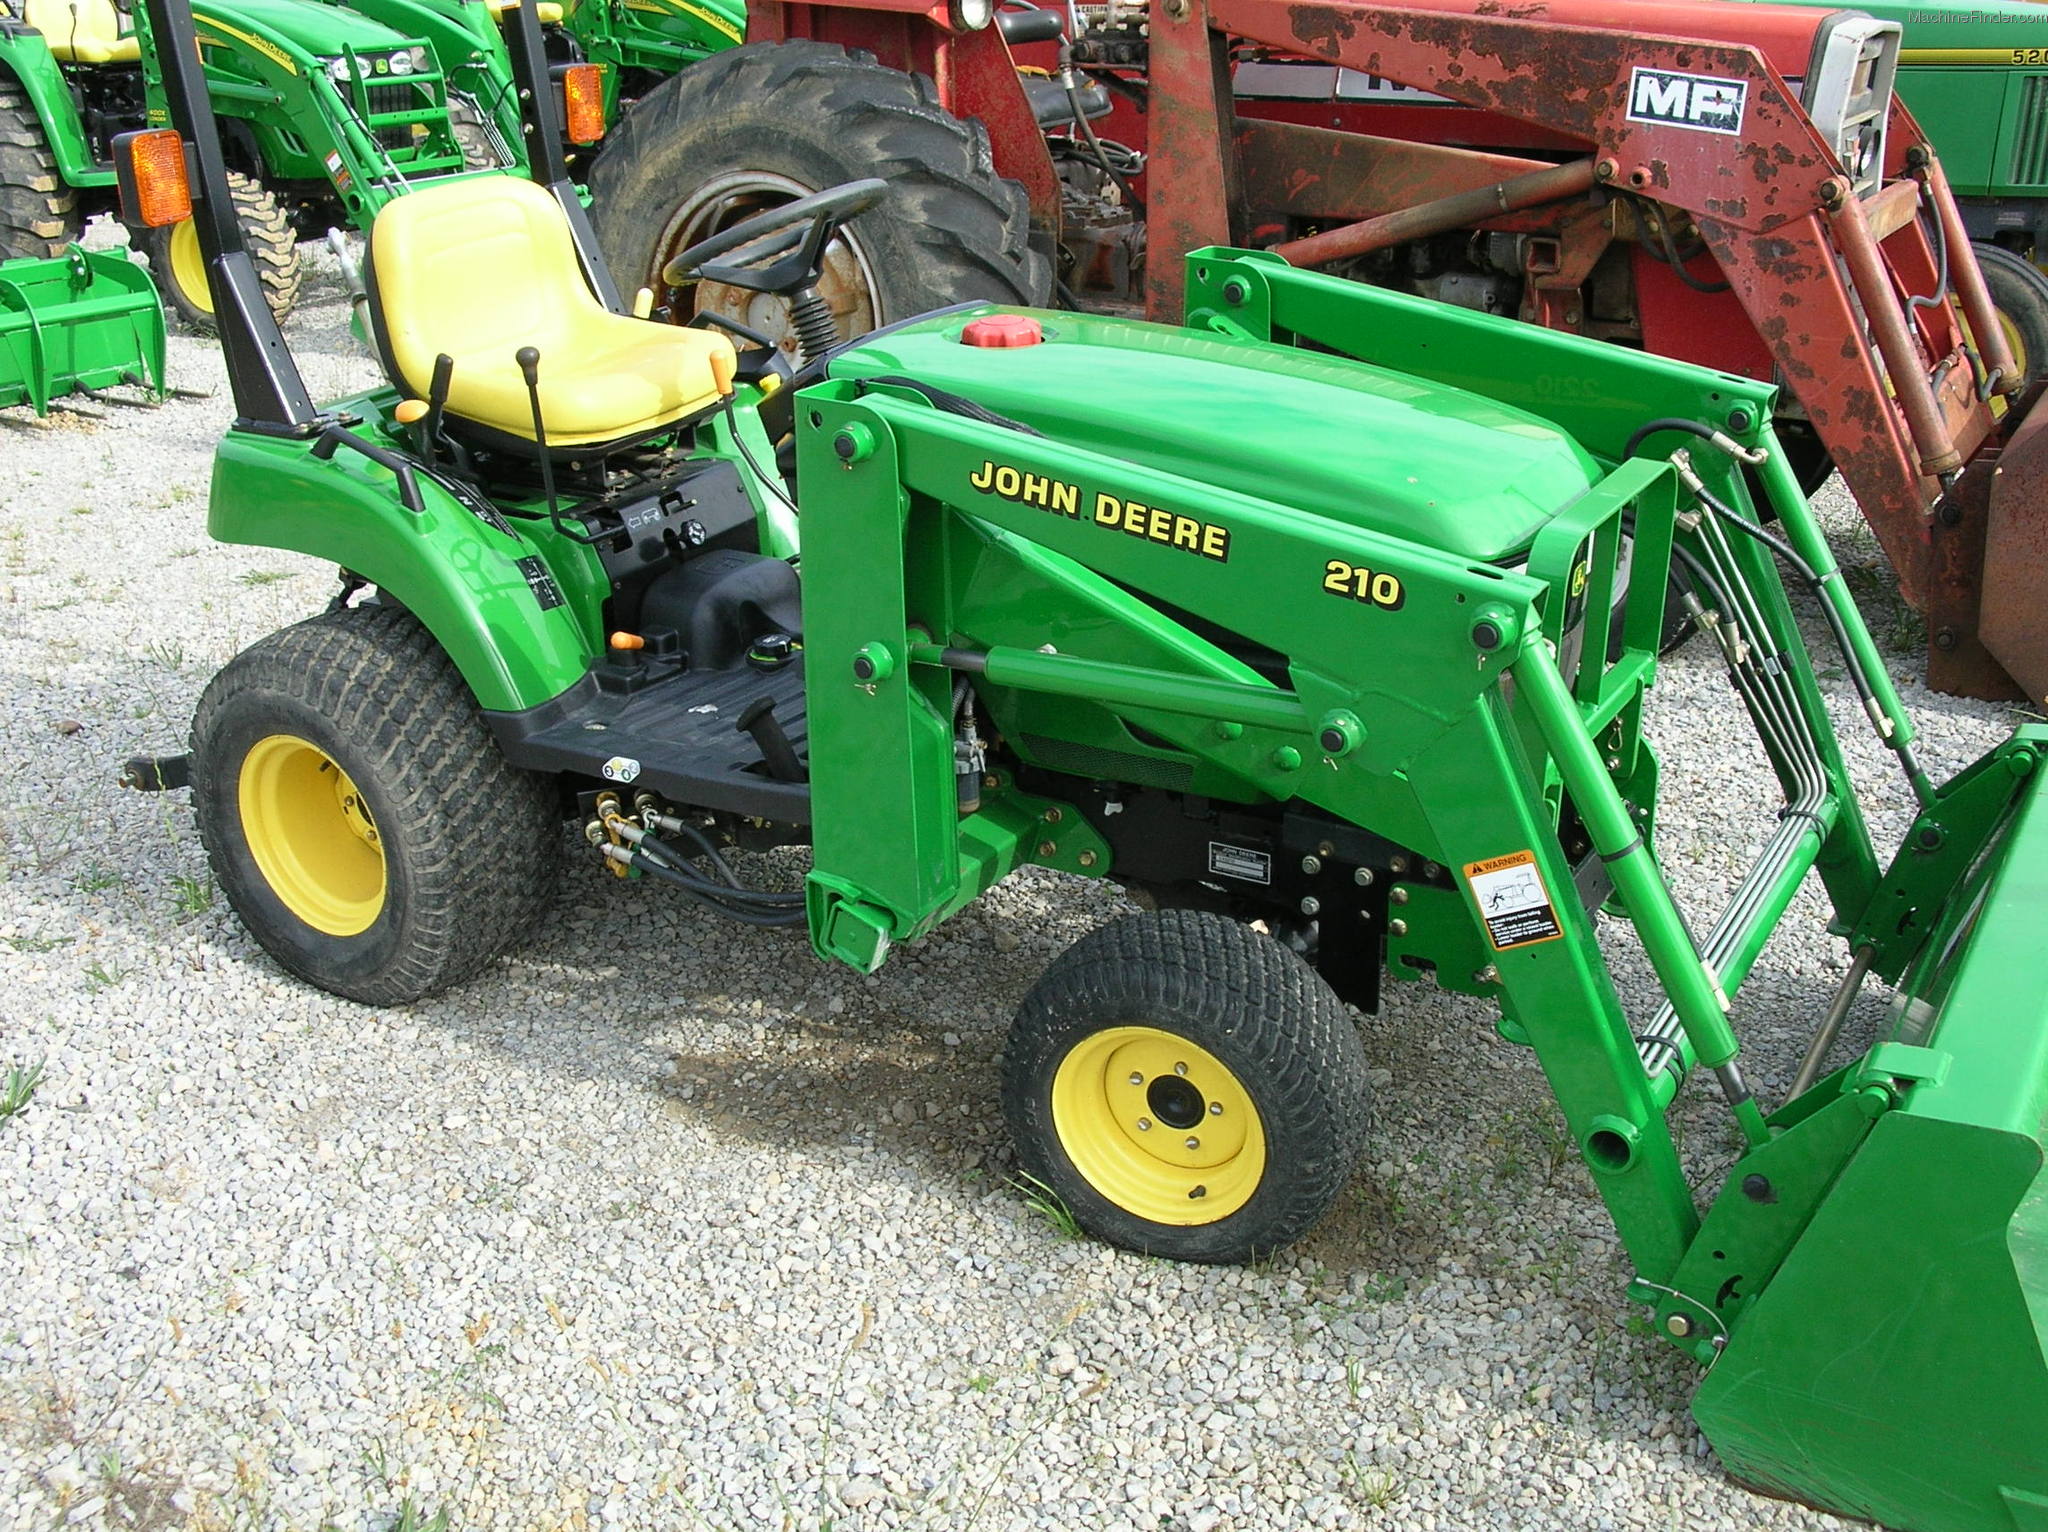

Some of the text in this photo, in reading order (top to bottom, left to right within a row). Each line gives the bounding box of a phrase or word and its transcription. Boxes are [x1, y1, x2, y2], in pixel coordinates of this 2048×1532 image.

[1634, 75, 1739, 121] MF
[970, 460, 1232, 564] JOHN DEERE
[1323, 559, 1406, 612] 210
[1483, 854, 1527, 870] WARNING
